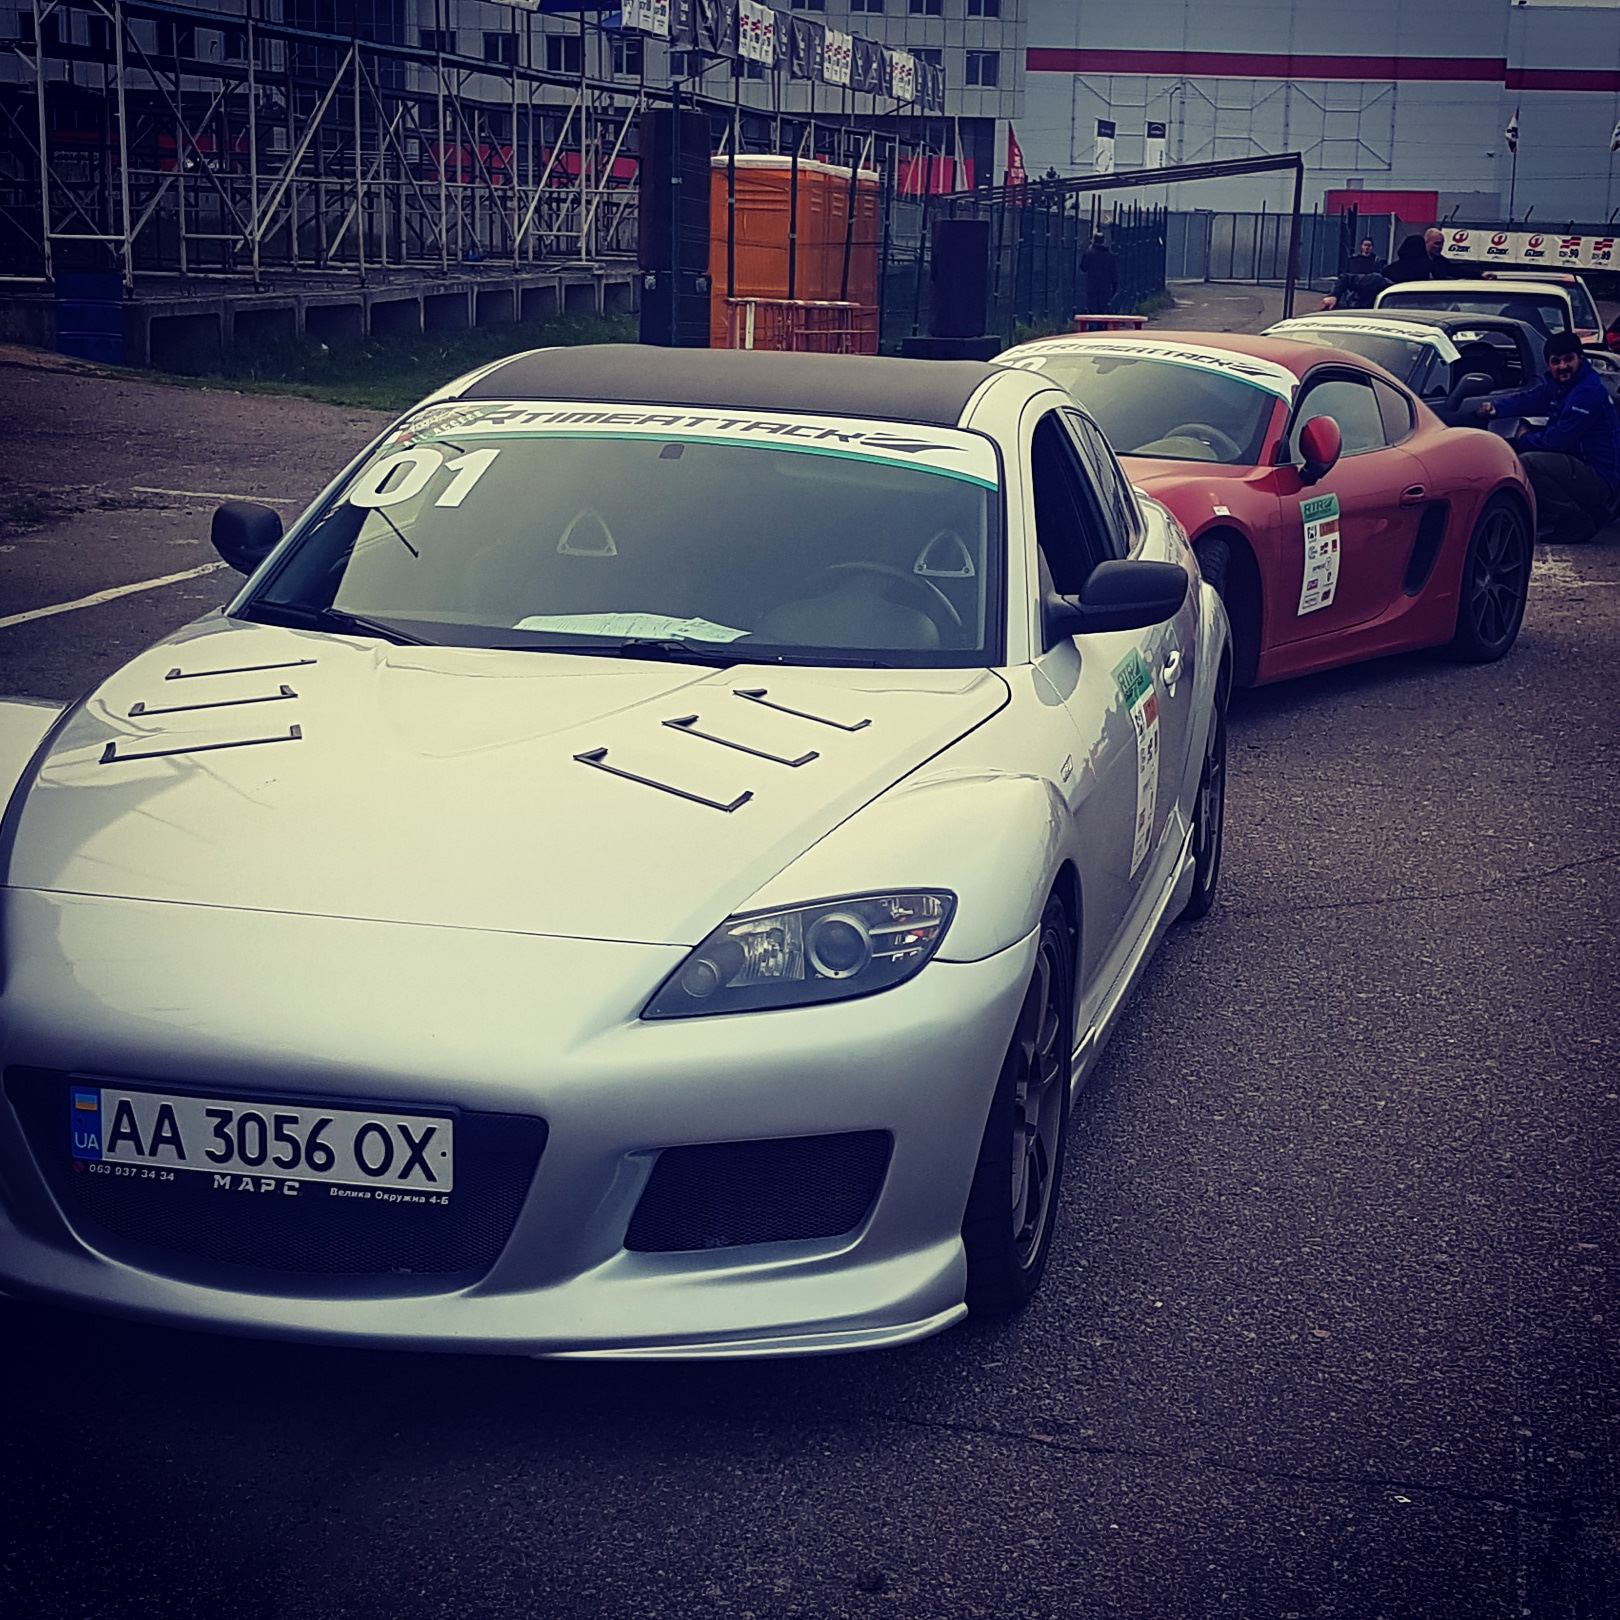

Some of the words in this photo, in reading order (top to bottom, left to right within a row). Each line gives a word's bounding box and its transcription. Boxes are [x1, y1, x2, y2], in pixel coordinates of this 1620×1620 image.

[350, 449, 500, 508] 01
[74, 1131, 99, 1150] UA
[106, 1098, 187, 1161] AA
[204, 1107, 336, 1173] 3056
[353, 1121, 439, 1183] OX
[88, 1163, 111, 1175] 063
[141, 1169, 156, 1179] 34
[160, 1171, 175, 1181] 34
[330, 1187, 371, 1199] Велика
[375, 1191, 426, 1203] Окружна
